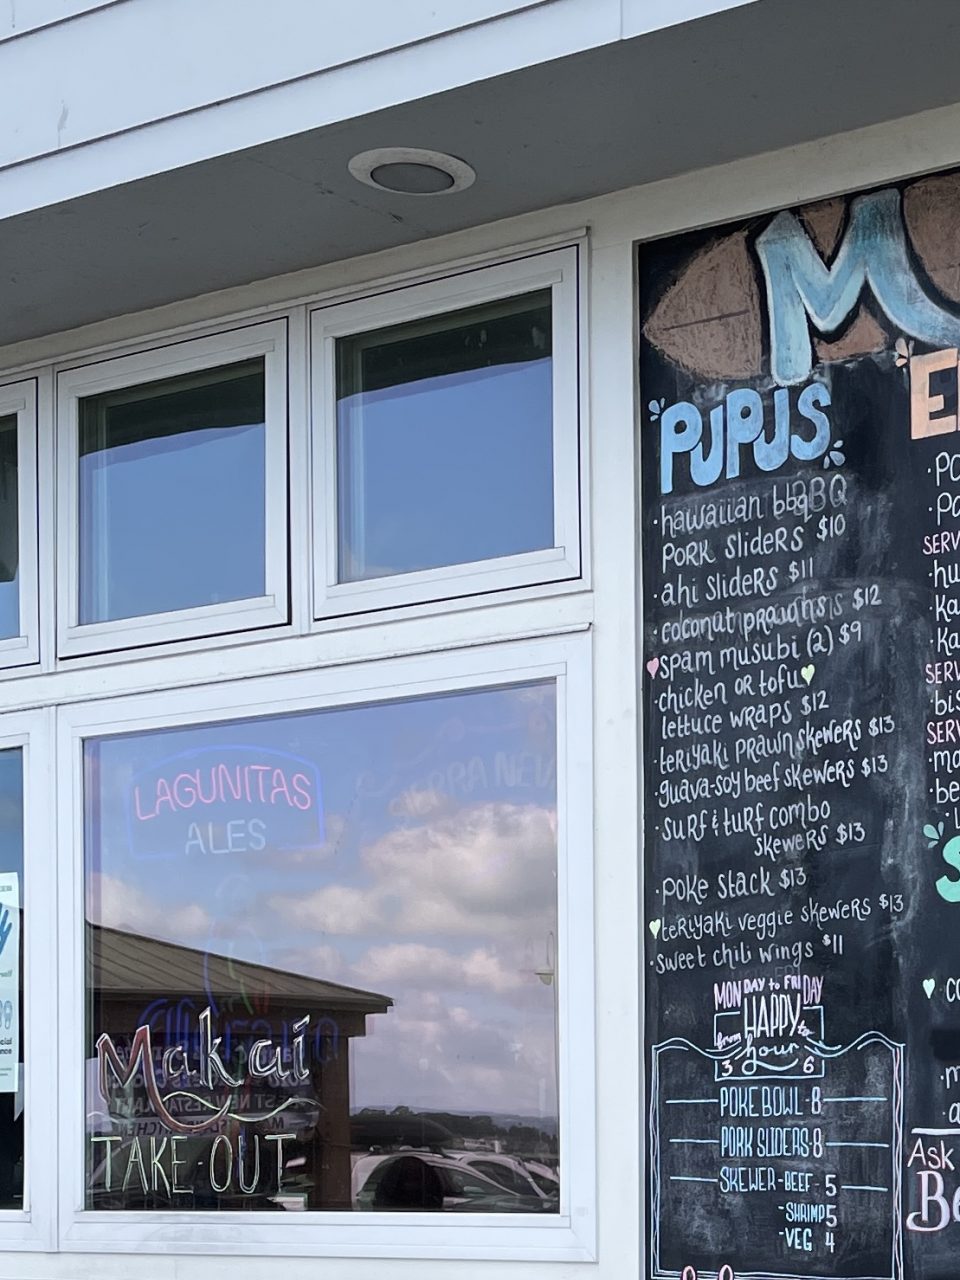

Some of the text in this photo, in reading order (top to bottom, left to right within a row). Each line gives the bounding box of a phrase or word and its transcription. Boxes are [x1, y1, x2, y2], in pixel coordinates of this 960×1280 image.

[817, 513, 846, 541] $10
[789, 557, 814, 583] $11
[852, 584, 882, 611] $12
[720, 633, 801, 670] musubi
[806, 625, 834, 658] (2)
[839, 621, 862, 645] $9
[661, 690, 829, 740] lettuce $12
[868, 715, 895, 737] $13
[861, 755, 889, 778] $13
[134, 764, 313, 822] LAGUNITAS
[184, 819, 267, 856] ALES
[836, 821, 866, 845] $13
[778, 867, 808, 890] $13
[878, 893, 904, 913] $13
[822, 933, 844, 955] $11
[743, 992, 801, 1039] HAPPY
[96, 1006, 311, 1133] Makai
[720, 1086, 804, 1117] POKE BOWL
[721, 1127, 753, 1158] PORK
[907, 1137, 955, 1169] Ask
